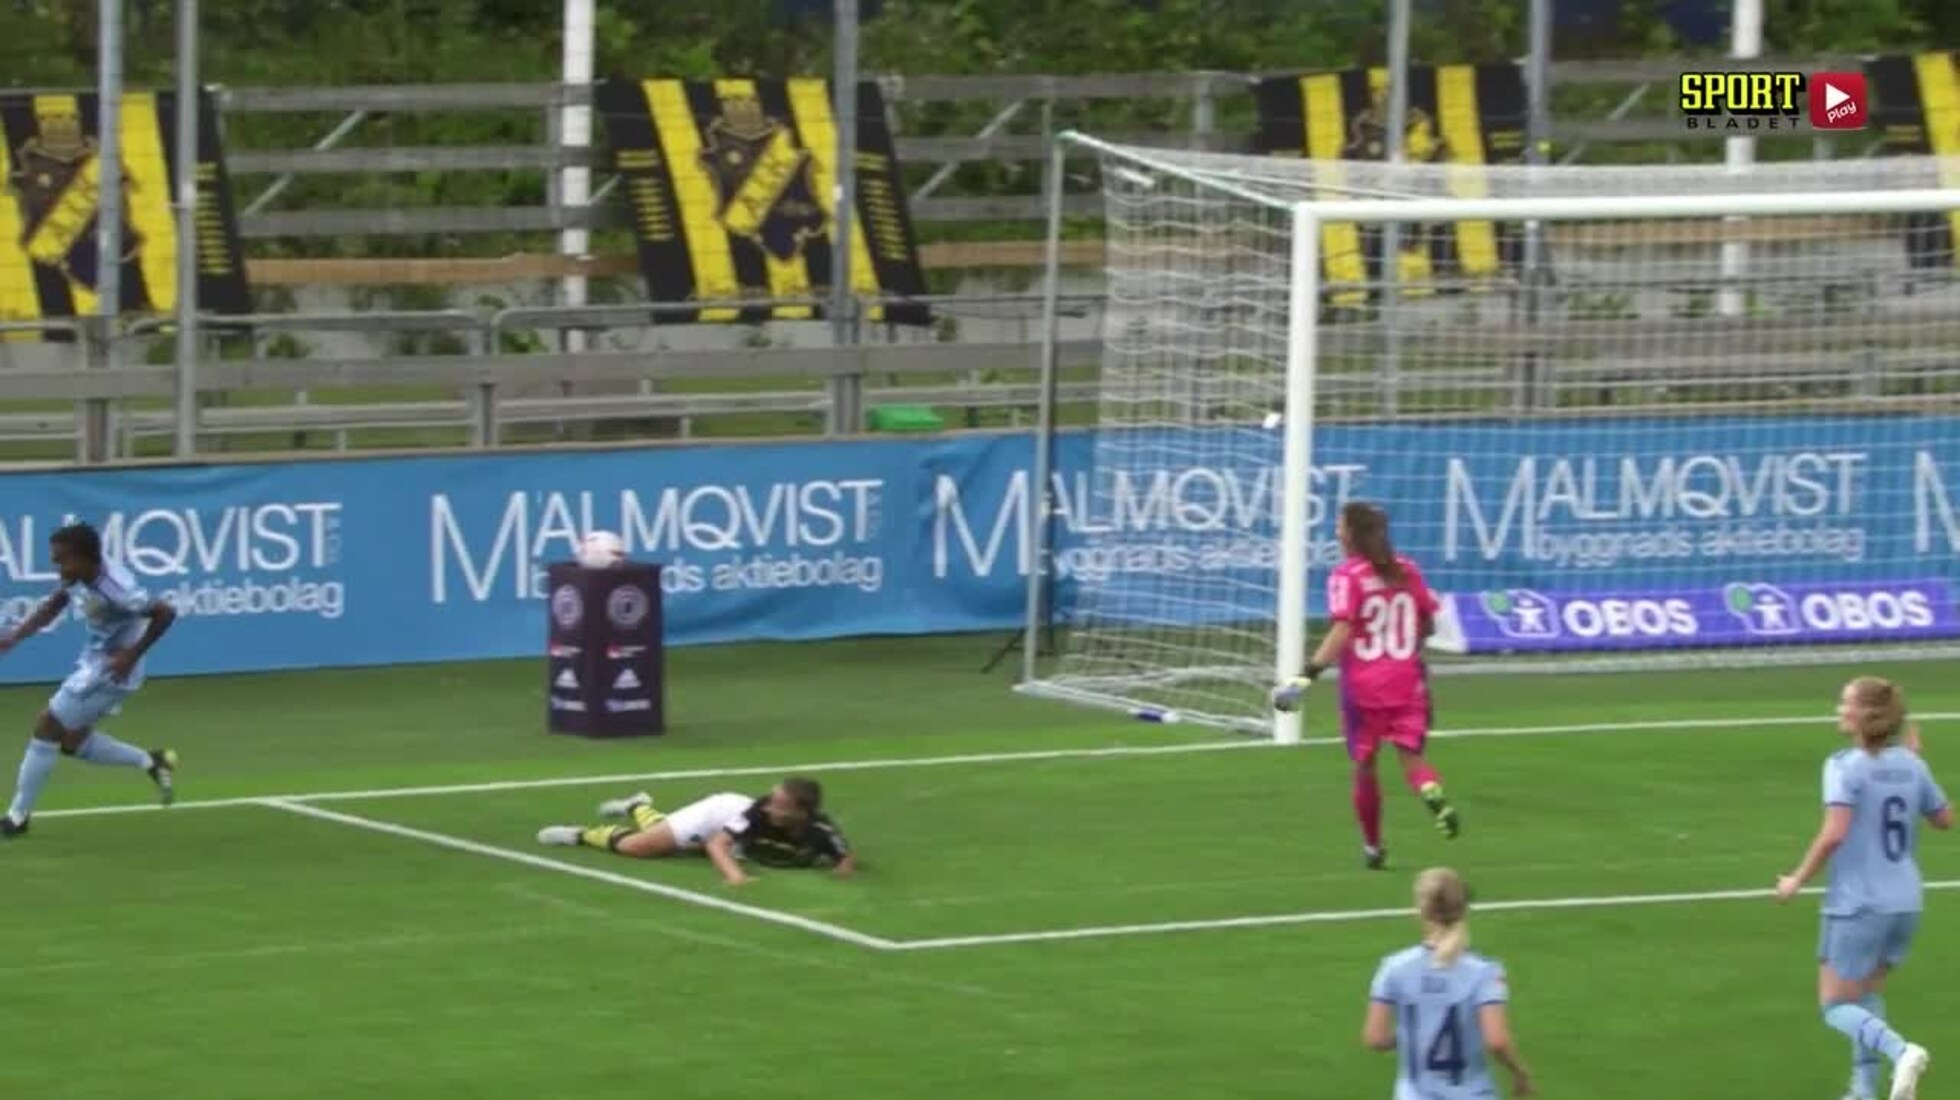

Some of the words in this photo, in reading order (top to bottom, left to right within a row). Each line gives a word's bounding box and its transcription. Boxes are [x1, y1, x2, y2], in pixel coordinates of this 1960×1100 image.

[1445, 452, 1868, 562] MALMQVIST
[711, 550, 883, 592] aktiebolag
[1354, 592, 1418, 662] 30
[1801, 590, 1934, 631] OBOS
[1881, 795, 1907, 863] 6
[1405, 1003, 1468, 1086] 14
